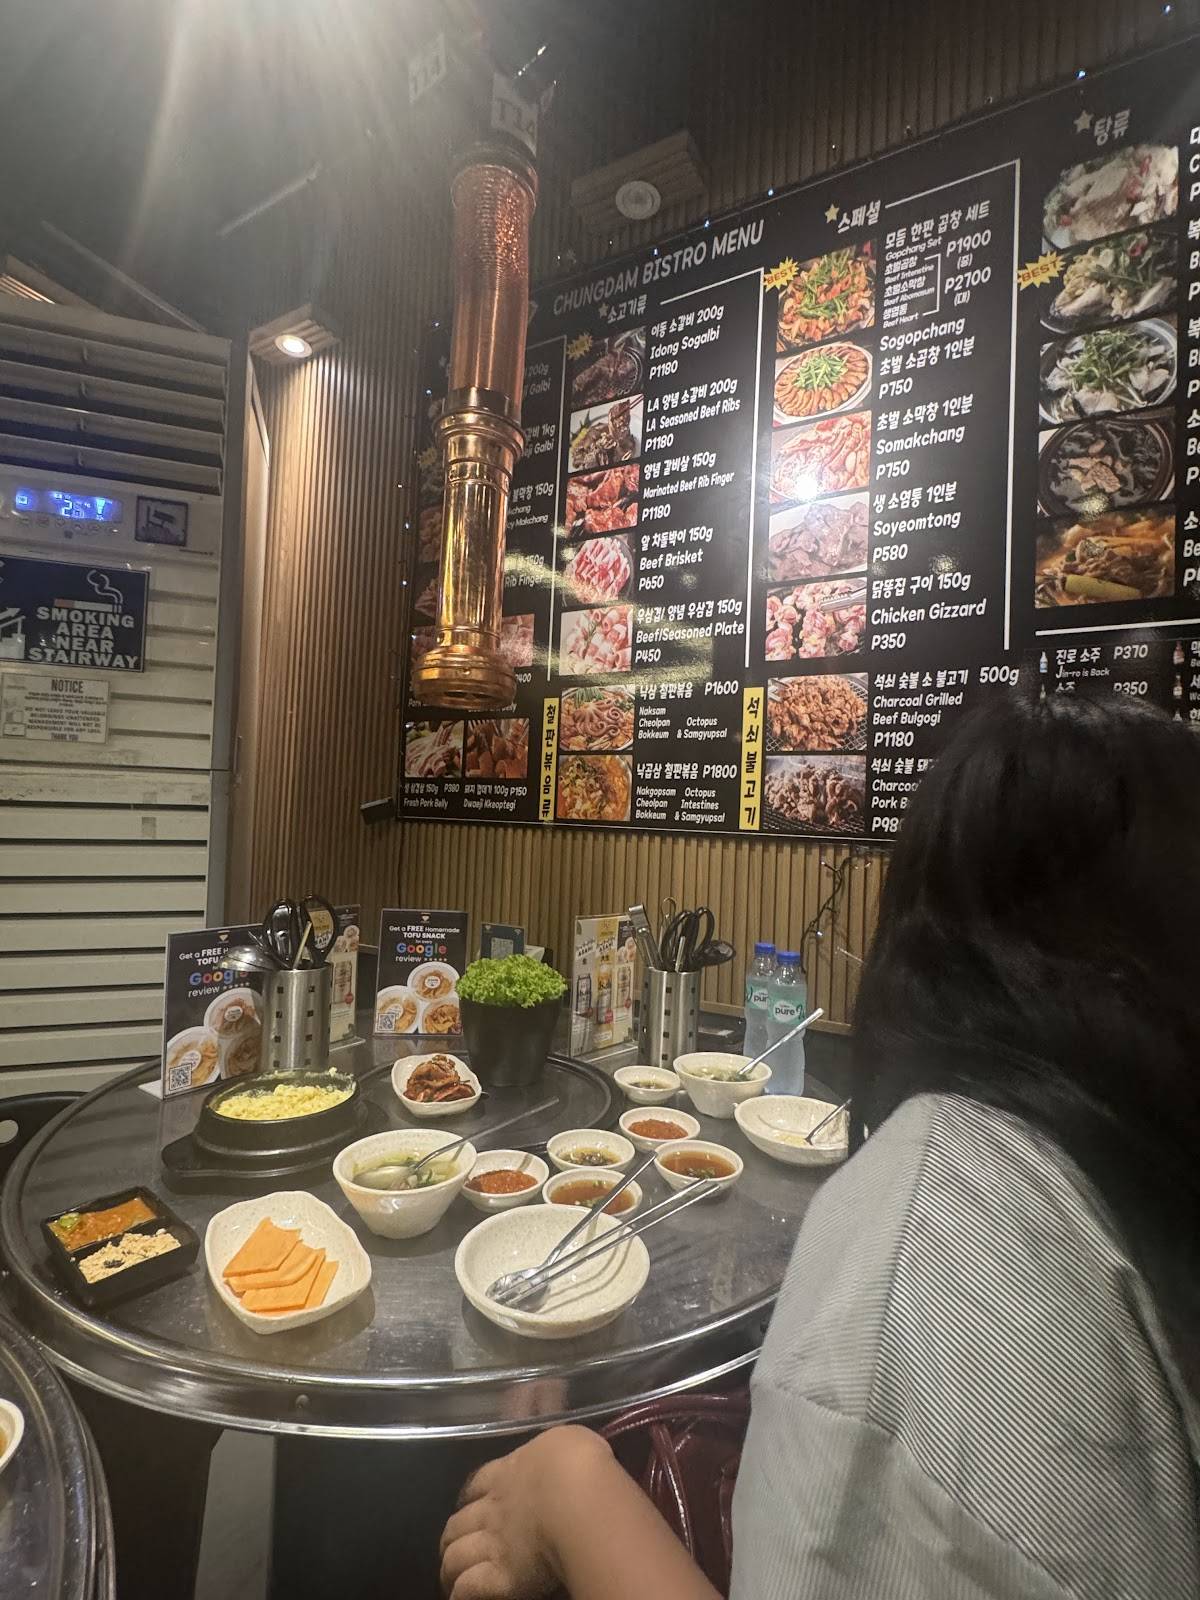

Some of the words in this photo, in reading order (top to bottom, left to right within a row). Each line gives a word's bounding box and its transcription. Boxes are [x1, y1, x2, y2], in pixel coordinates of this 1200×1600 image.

[1094, 109, 1130, 146] 탕류
[838, 200, 881, 234] 스페셜
[911, 219, 935, 242] 한판
[938, 209, 962, 234] 곱창
[965, 200, 991, 222] 세트
[886, 243, 926, 261] Gopchang
[927, 236, 942, 248] Set
[946, 229, 992, 258] P1900
[553, 265, 639, 316] CHUNGDAM
[642, 240, 707, 284] BISTRO
[711, 219, 765, 260] MENU
[766, 263, 798, 285] BEST
[1022, 259, 1059, 282] BEST
[944, 266, 992, 294] P2700
[607, 294, 648, 324] 소고기류
[651, 320, 668, 339] 이동
[669, 312, 694, 334] 소갈비
[697, 304, 724, 324] 200g
[900, 312, 919, 325] Heart
[650, 341, 680, 360] Idong
[681, 325, 720, 351] Sogalbi
[880, 318, 966, 352] Sogopchang
[880, 354, 903, 376] 초벌
[905, 344, 940, 370] 소곱창
[944, 336, 975, 360] 1인분
[649, 360, 678, 380] P1180
[529, 378, 551, 396] Galbi
[647, 397, 660, 412] LA
[662, 391, 680, 410] 양념
[681, 384, 708, 404] 소갈비
[709, 378, 738, 397] 200g
[878, 377, 914, 400] P750
[646, 418, 656, 432] LA
[660, 406, 700, 430] Seasoned
[700, 399, 722, 420] Beef
[722, 397, 741, 414] Ribs
[876, 410, 900, 432] 초벌
[902, 401, 939, 426] 소막창
[942, 393, 974, 417] 1인분
[541, 424, 556, 437] 1kg
[534, 438, 554, 455] Galbi
[644, 433, 674, 452] P1180
[876, 426, 966, 455] Somakchang
[643, 461, 662, 481] 양념
[663, 454, 690, 476] 갈비살
[692, 451, 717, 468] 150g
[876, 459, 910, 480] P750
[534, 482, 554, 497] 150g
[643, 480, 680, 500] Marinated
[680, 476, 698, 493] Beef
[698, 473, 710, 489] Rib
[710, 471, 735, 487] Finger
[872, 494, 886, 514] 생
[888, 488, 922, 510] 소염통
[926, 481, 958, 504] 1인분
[516, 514, 549, 529] Makchang
[641, 503, 671, 522] P1180
[872, 512, 962, 538] Soyeomtong
[652, 528, 687, 549] 차돌박이
[688, 525, 714, 542] 150g
[640, 556, 664, 571] Beef
[664, 548, 704, 568] Brisket
[872, 544, 908, 564] P580
[638, 574, 665, 592] P650
[872, 577, 906, 600] 닭똥집
[909, 574, 934, 594] 구이
[937, 572, 972, 591] 150g
[36, 606, 135, 629] SMOKING
[668, 604, 686, 622] 양념
[687, 600, 714, 620] 우삼겹
[716, 598, 742, 616] 150g
[871, 607, 926, 626] Chicken
[928, 598, 987, 620] Gizzard
[56, 622, 115, 640] AREA
[636, 623, 713, 644] Beef/Seasoned
[714, 620, 745, 638] Plate
[56, 636, 115, 654] NEAR
[870, 632, 906, 650] P350
[27, 648, 139, 669] STAIRWAY
[634, 648, 662, 664] P450
[1055, 648, 1077, 666] 진로
[1080, 647, 1101, 664] 소주
[1113, 644, 1148, 660] P370
[874, 674, 896, 690] 석쇠
[898, 672, 920, 690] 숯불
[922, 672, 933, 688] 소
[936, 669, 969, 688] 불고기
[979, 666, 1020, 686] 500g
[1082, 668, 1088, 677] is
[1090, 667, 1110, 677] Back
[51, 680, 84, 694] NOTICE
[640, 683, 658, 701] 낙삼
[659, 681, 694, 700] 철판볶음
[704, 680, 740, 696] P1600
[1113, 681, 1148, 696] P350
[873, 694, 924, 708] Charcoal
[924, 692, 964, 707] Grilled
[638, 706, 667, 716] Naksam
[872, 712, 898, 726] Beef
[900, 710, 942, 727] Bulgogi
[638, 717, 671, 728] Cheolpan
[686, 716, 718, 728] Octopus
[638, 730, 670, 740] Bokkeum
[683, 728, 728, 742] Samgyupsal
[873, 731, 915, 748] P1180
[744, 696, 760, 826] 석쇠불고기
[870, 758, 892, 775] 석쇠
[894, 757, 914, 775] 숯불
[636, 762, 663, 780] 낙곱삼
[664, 762, 699, 780] 철판볶음
[702, 764, 738, 780] P1800
[494, 785, 509, 797] 100g
[510, 786, 528, 797] P150
[684, 787, 716, 798] Octopus
[420, 798, 434, 808] Pork
[636, 798, 668, 809] Cheolpan
[680, 798, 720, 810] Intestines
[871, 796, 898, 809] Pork
[635, 809, 667, 820] Bokkeum
[682, 811, 726, 825] Samgyupsal
[872, 816, 904, 833] P98
[422, 932, 446, 940] SNACK
[178, 952, 194, 960] Get
[201, 947, 222, 958] FREE
[396, 942, 448, 957] Google
[196, 956, 219, 966] TOFU
[188, 985, 221, 998] review
[774, 1006, 796, 1016] pure
